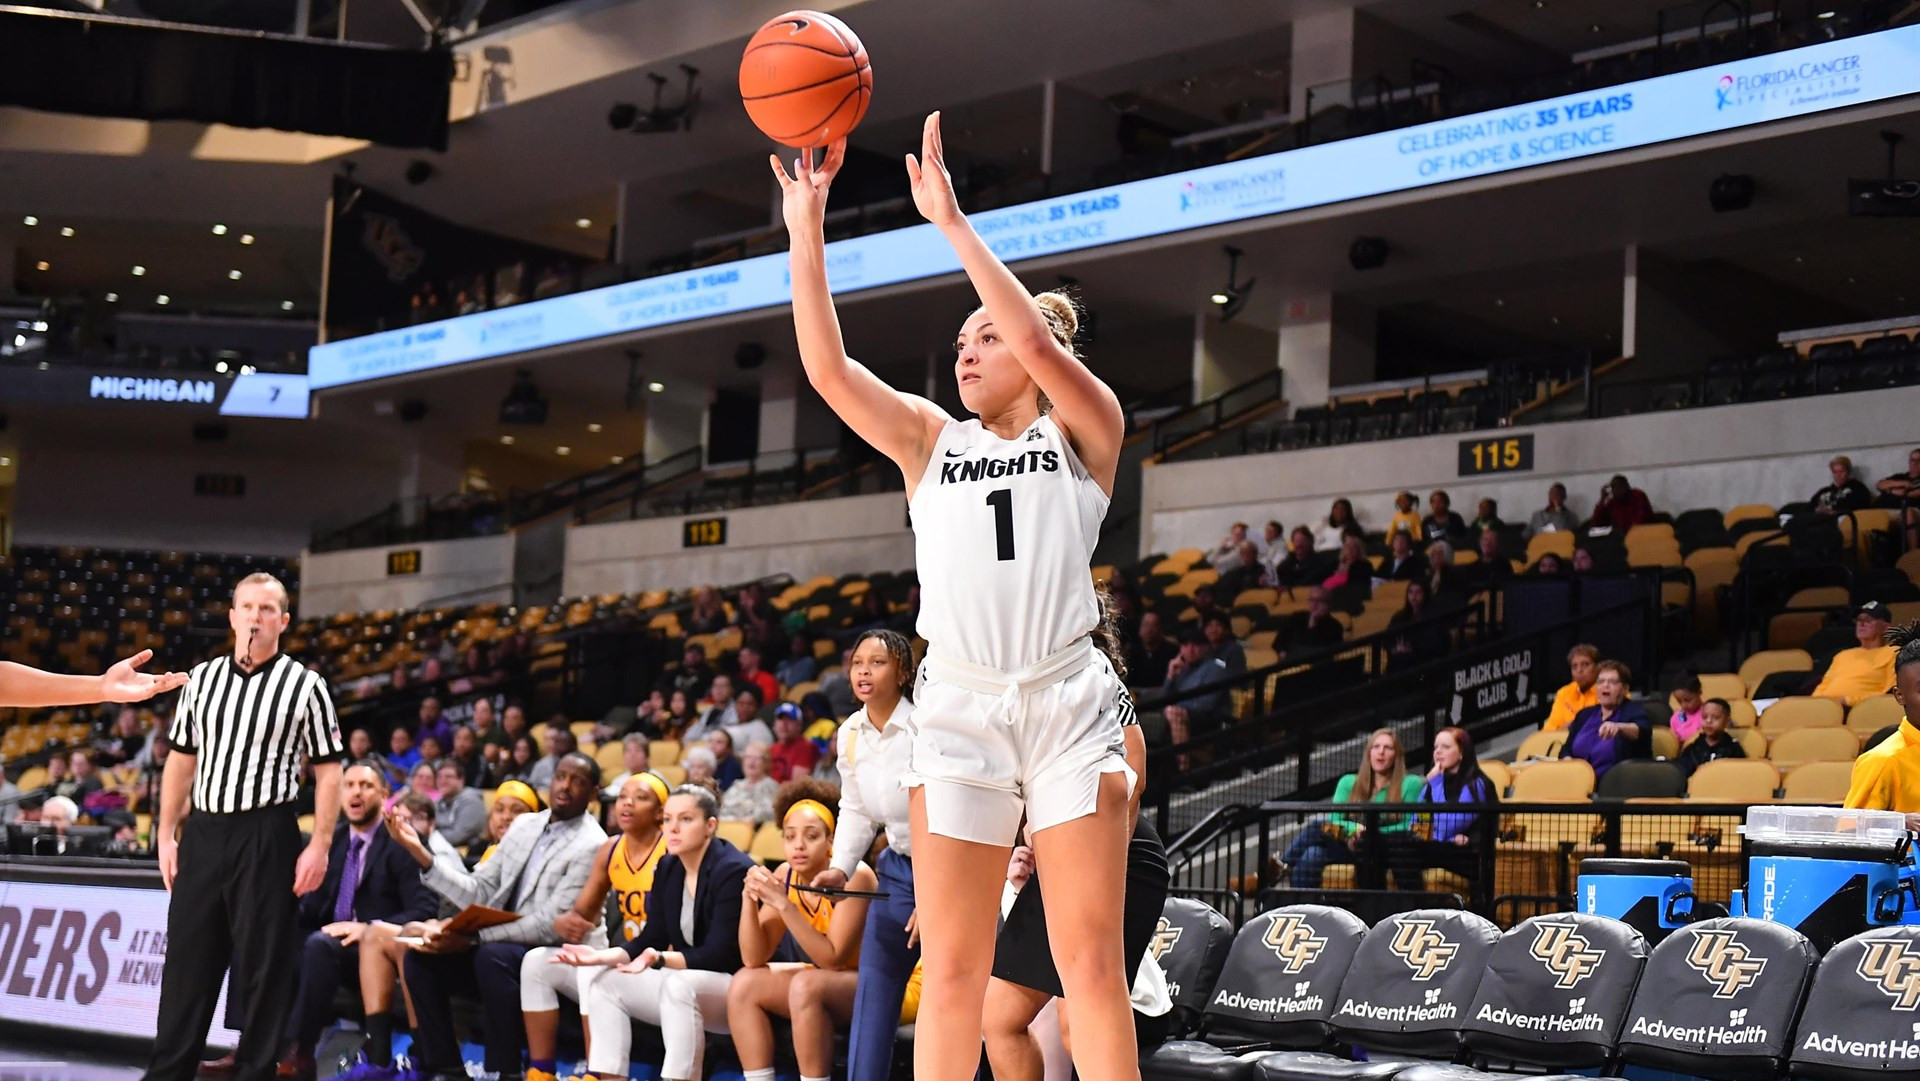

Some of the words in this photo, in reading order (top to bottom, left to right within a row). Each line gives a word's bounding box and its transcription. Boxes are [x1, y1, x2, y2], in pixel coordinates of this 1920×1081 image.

[1736, 68, 1797, 91] FLORIDA
[1799, 54, 1861, 79] CANCER
[1397, 112, 1531, 155] CELEBRATING
[1535, 108, 1558, 128] 35
[1563, 93, 1634, 122] YEARS
[1418, 157, 1446, 177] OF
[1451, 144, 1505, 170] HOPE
[1509, 145, 1521, 161] &
[1527, 123, 1615, 158] SCIENCE
[1070, 194, 1121, 216] YEARS
[1043, 219, 1107, 245] SCIENCE
[90, 376, 215, 403] MICHIGAN
[269, 385, 281, 404] 7
[940, 450, 1059, 485] KNIGHTS
[1471, 438, 1520, 472] 115
[690, 520, 720, 545] 113
[986, 488, 1015, 561] 1
[393, 551, 416, 574] 112
[1454, 661, 1492, 692] BLACK
[1492, 659, 1502, 680] &
[1502, 649, 1532, 677] GOLD
[1477, 681, 1508, 710] CLUB
[127, 928, 149, 954] AT
[1261, 913, 1329, 975] UCF
[1388, 919, 1461, 982] UCF
[1528, 921, 1607, 990] UCF
[1684, 928, 1769, 999] UCF
